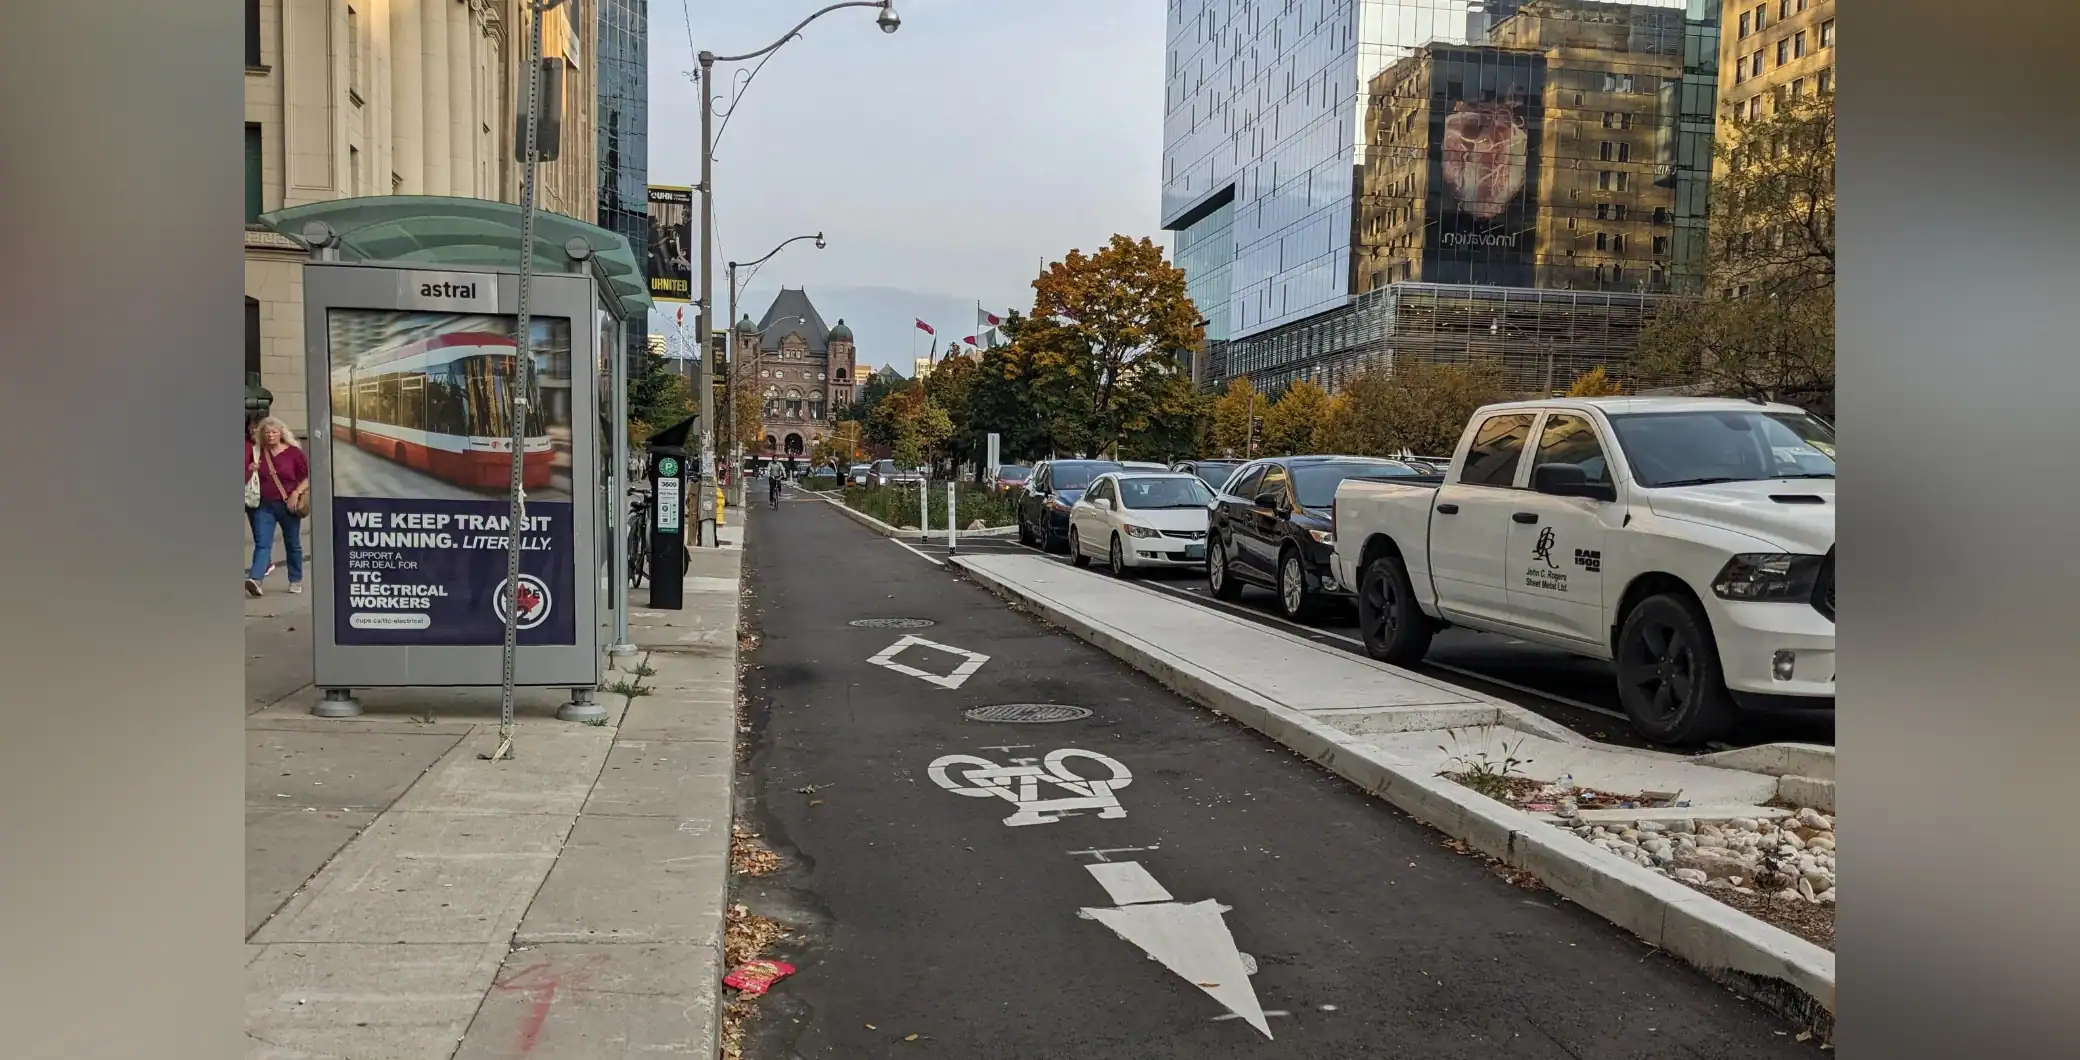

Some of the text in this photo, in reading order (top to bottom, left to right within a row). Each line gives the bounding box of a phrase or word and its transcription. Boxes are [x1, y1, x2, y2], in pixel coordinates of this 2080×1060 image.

[657, 191, 673, 200] UHN
[420, 281, 476, 299] astral
[651, 277, 688, 292] UHNITED
[347, 512, 382, 528] WE
[390, 513, 450, 529] KEEP
[348, 532, 552, 550] RUNNING. LITERLLY.
[349, 551, 402, 560] SUPPORT A
[1574, 549, 1600, 559] RAM
[349, 560, 418, 569] FAIR DEAL FOR
[1574, 557, 1600, 567] 1500
[349, 571, 382, 583] TTC
[1526, 567, 1539, 576] John
[1547, 570, 1567, 581] Rogers
[350, 583, 448, 597] ELECTRICAL
[1526, 577, 1541, 587] Sheet
[1542, 579, 1557, 590] Metal
[349, 596, 431, 609] WORKERS
